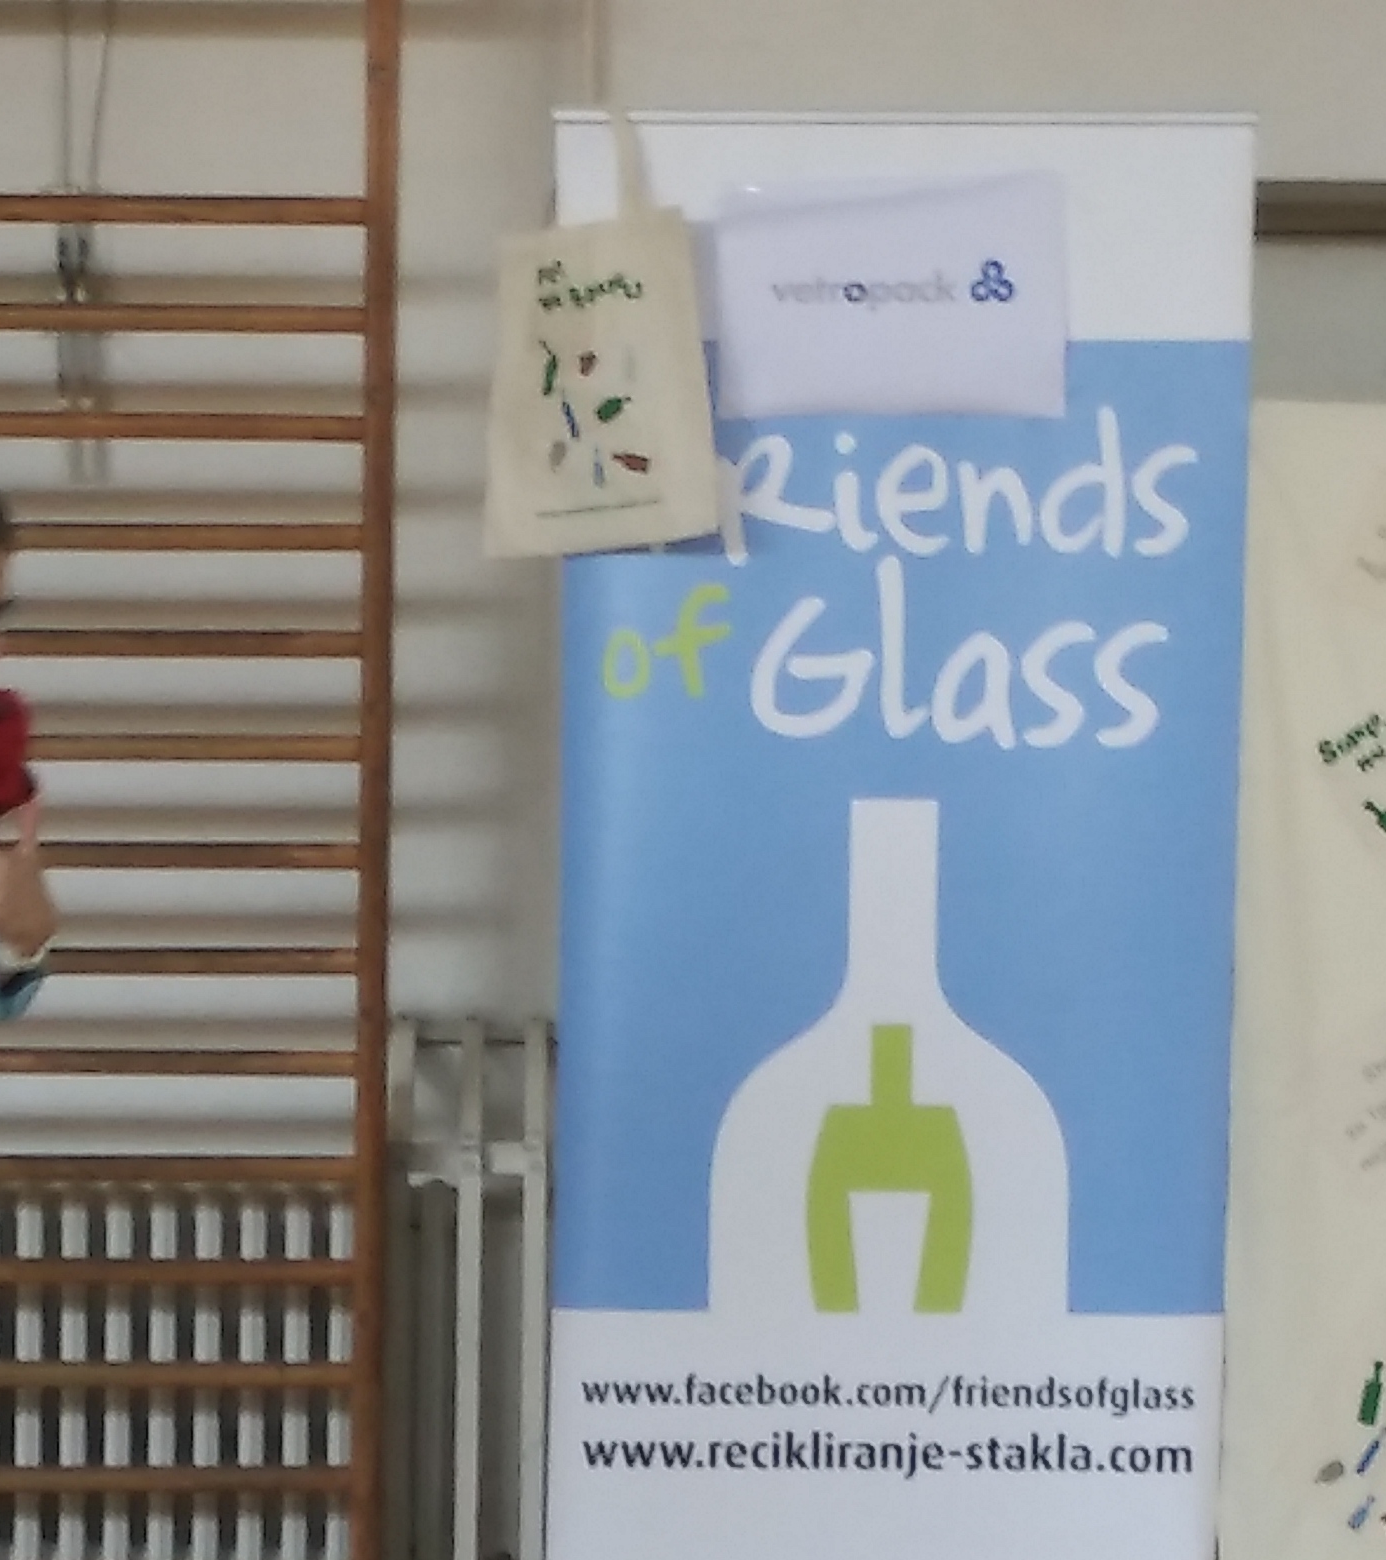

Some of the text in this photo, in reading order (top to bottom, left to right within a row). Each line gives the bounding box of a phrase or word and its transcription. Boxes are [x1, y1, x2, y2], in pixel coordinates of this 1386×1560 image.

[601, 582, 733, 699] of
[749, 555, 1171, 752] Glass
[581, 1373, 1195, 1415] www.facebook.com/friendsofglass
[581, 1431, 1194, 1478] www.recikliranje-stakla.com
